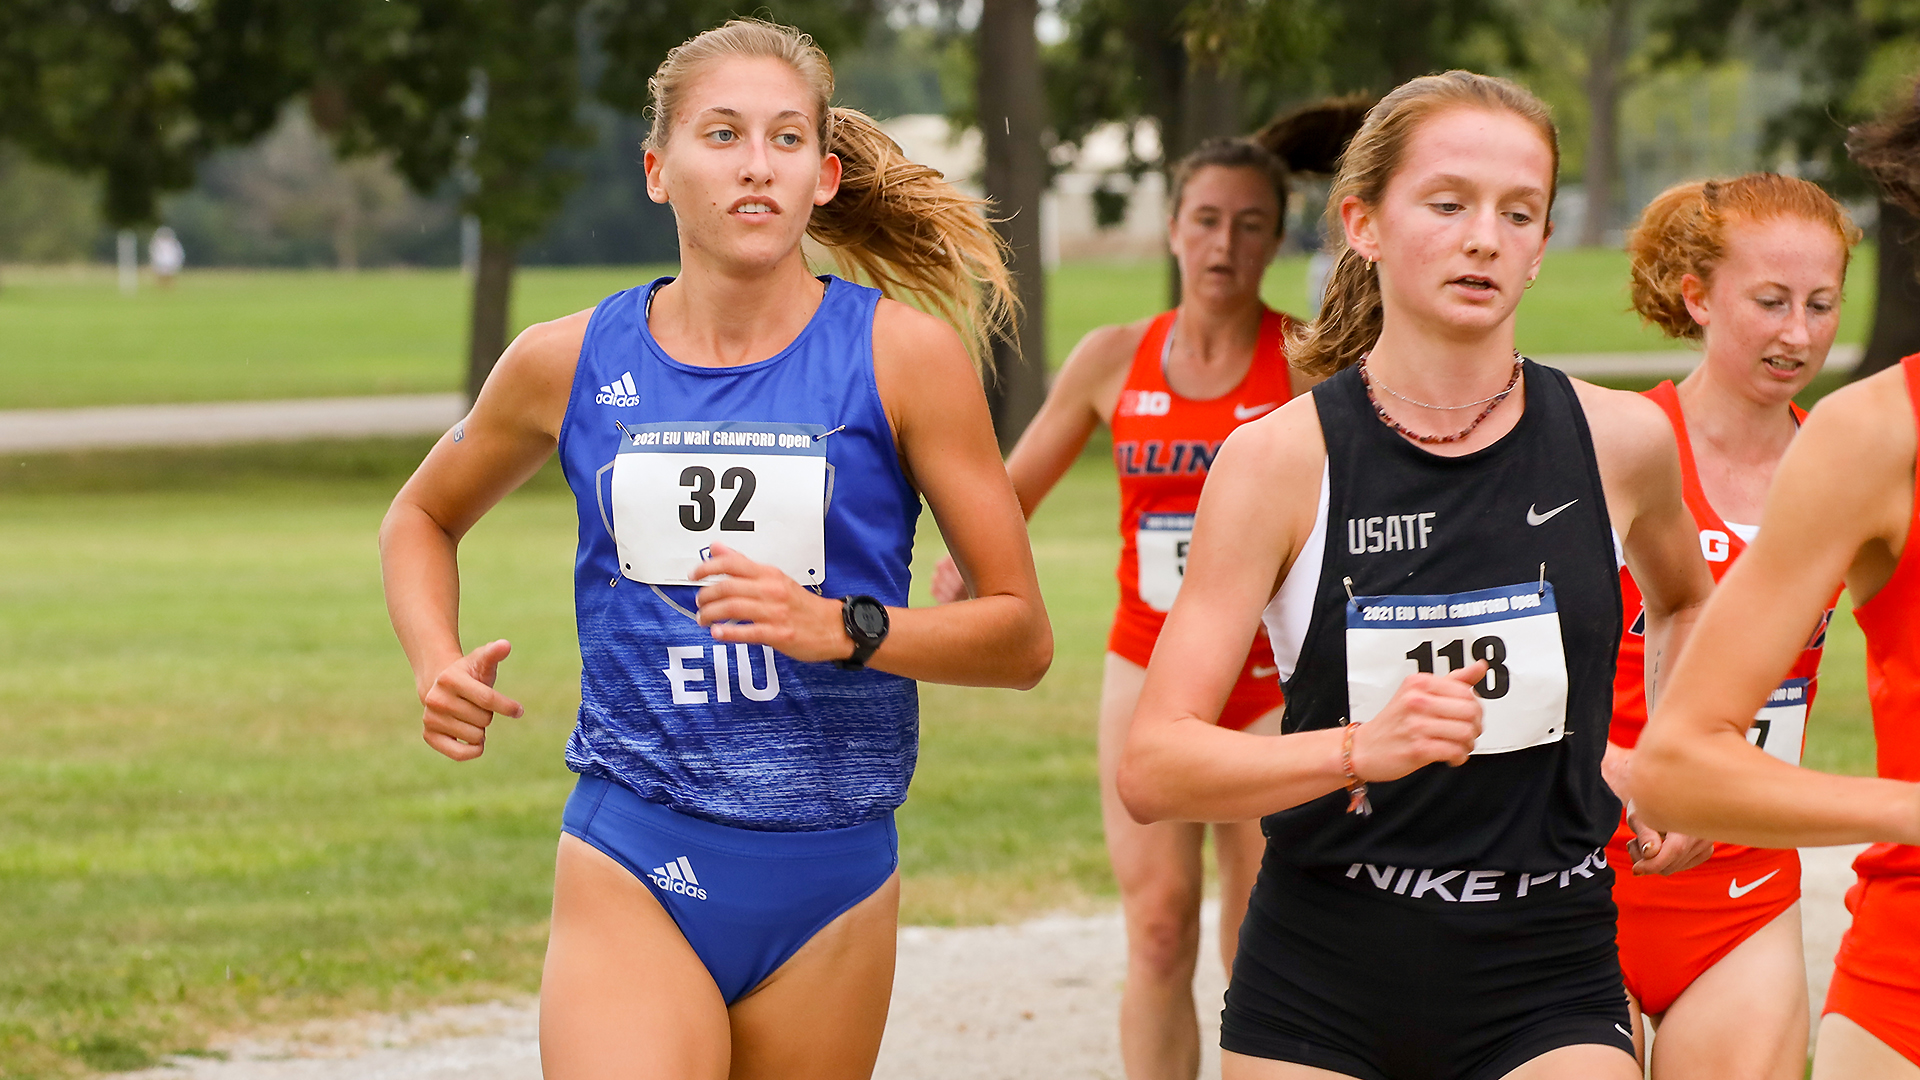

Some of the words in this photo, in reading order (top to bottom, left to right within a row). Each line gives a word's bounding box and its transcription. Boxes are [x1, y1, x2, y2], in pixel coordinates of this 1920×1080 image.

[595, 392, 641, 408] adidas
[632, 431, 661, 446] 2021
[662, 431, 682, 445] EIU
[712, 431, 776, 447] CRAWFORD
[777, 433, 811, 449] Open
[678, 466, 757, 532] 32
[1347, 511, 1436, 555] USATF
[1362, 605, 1395, 621] 2021
[661, 643, 781, 705] EIU
[1405, 635, 1510, 700] 118
[1345, 863, 1506, 903] NIKE
